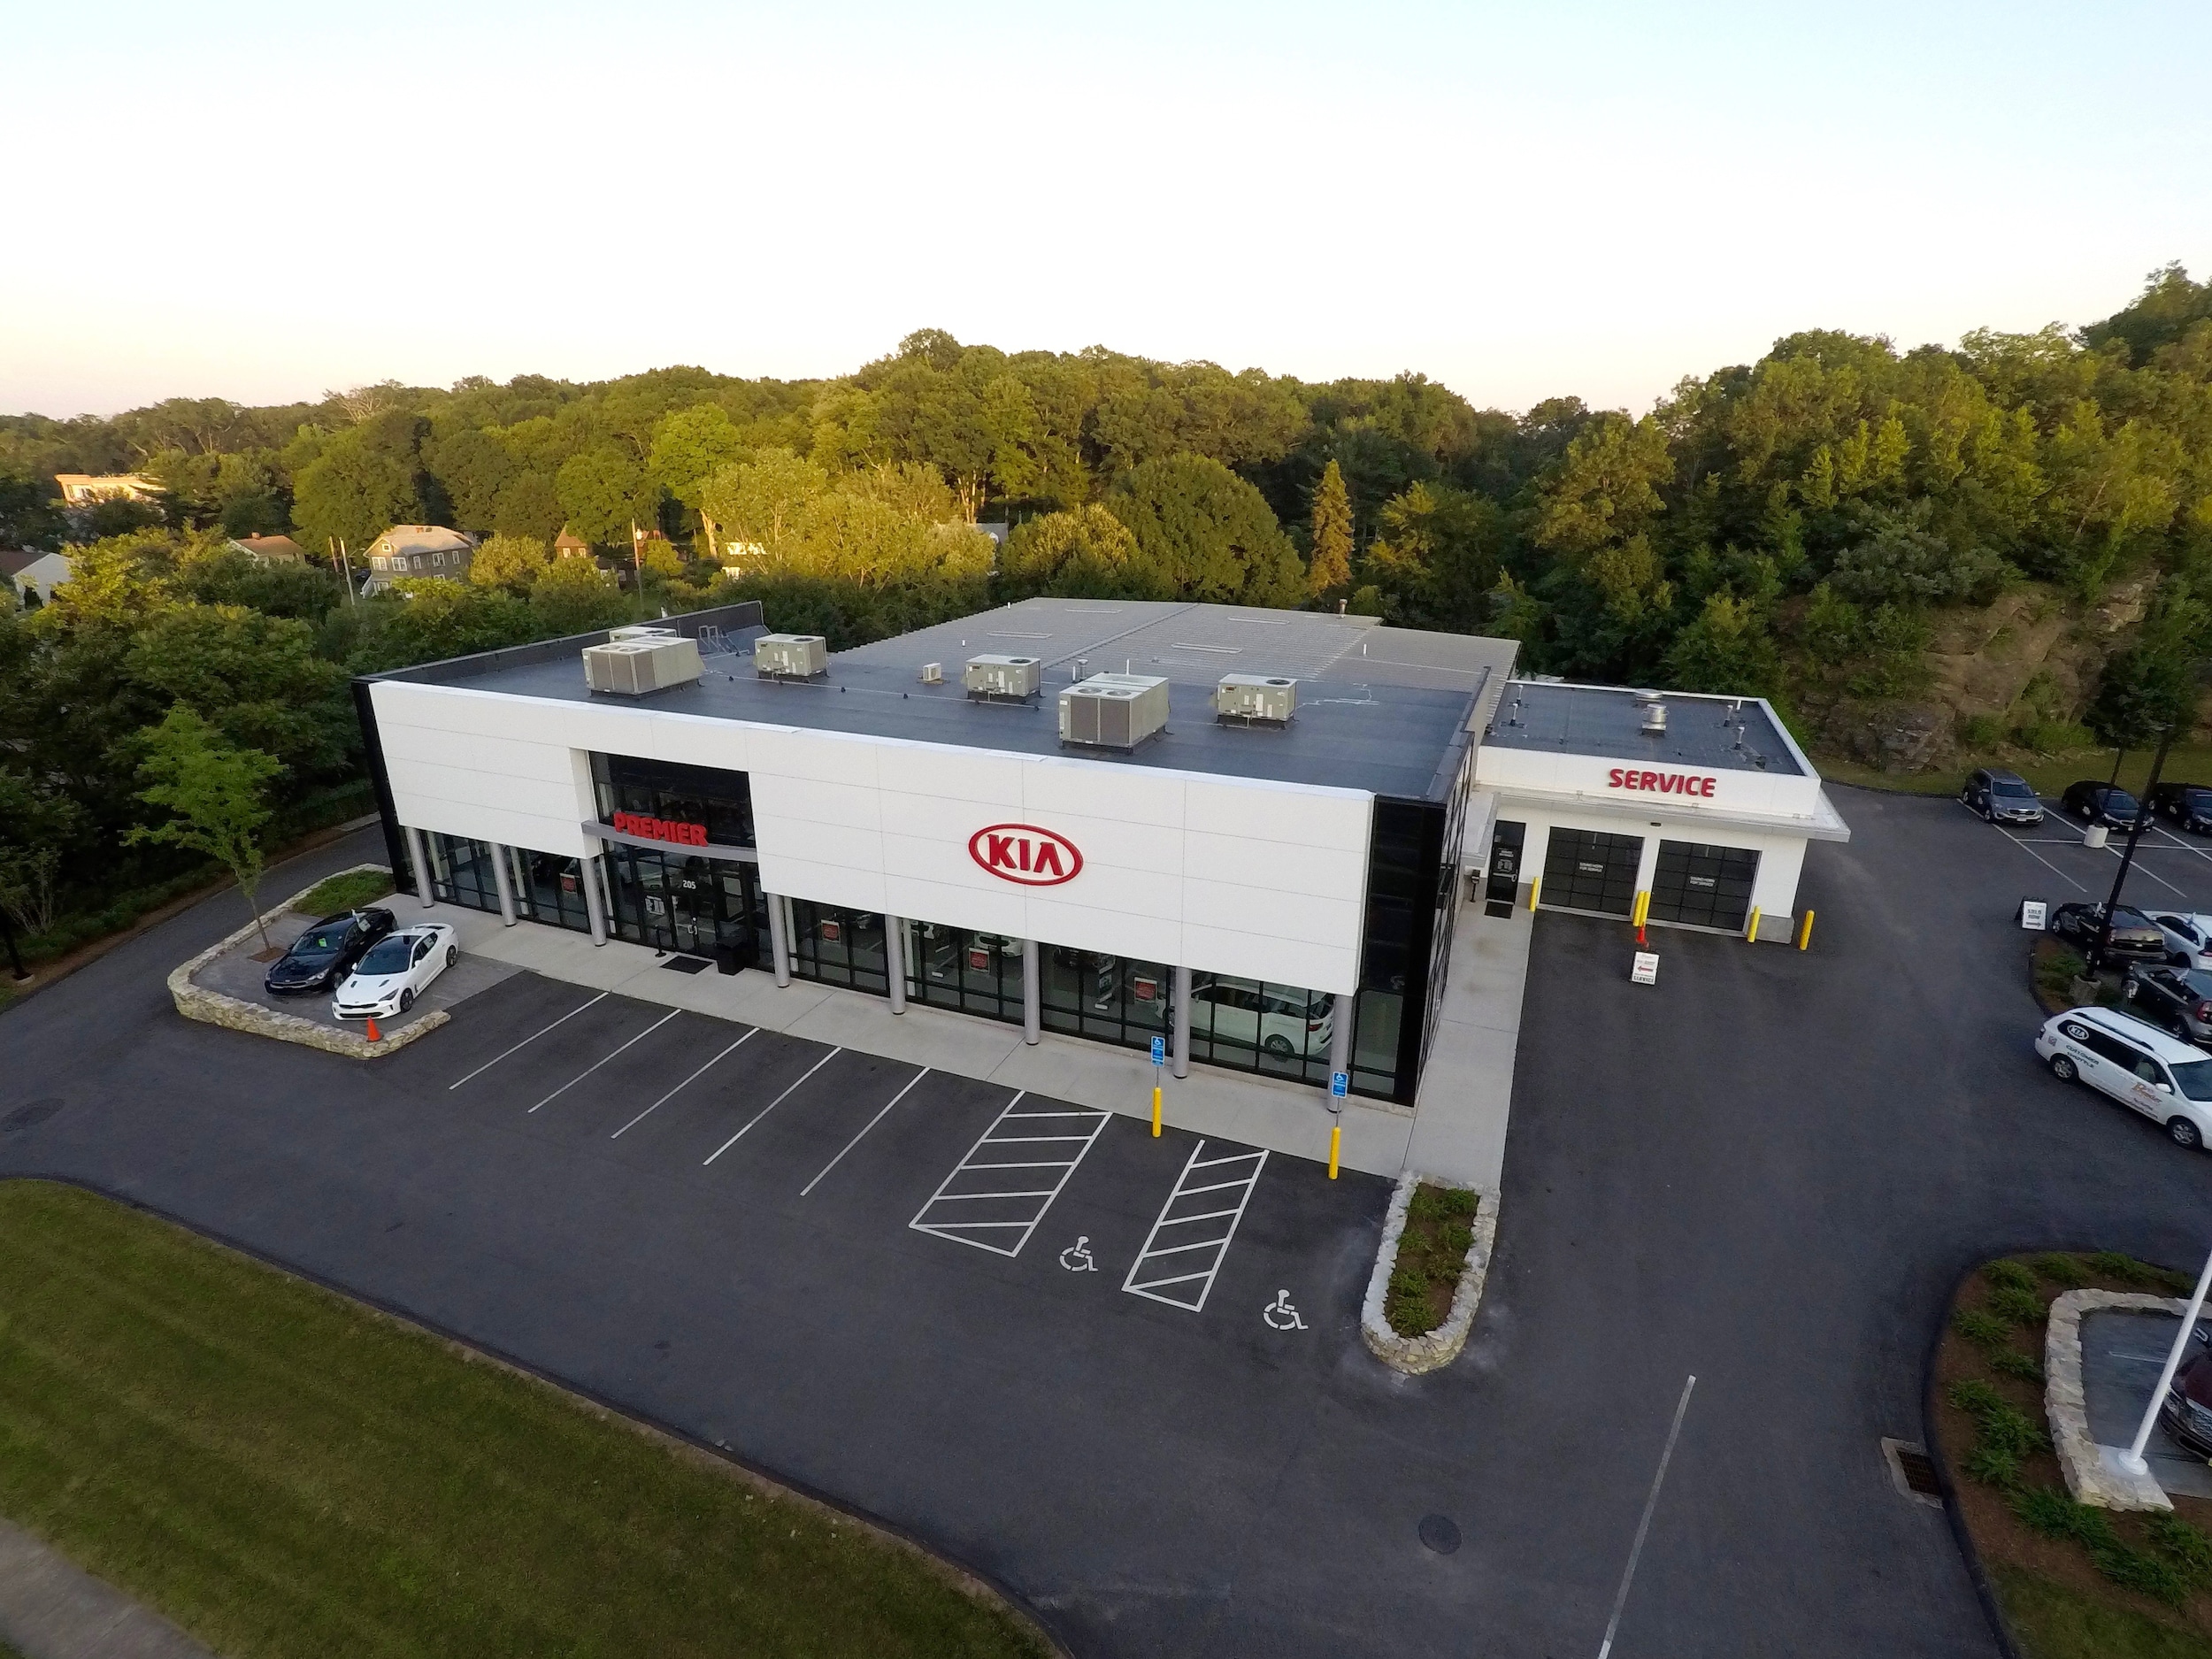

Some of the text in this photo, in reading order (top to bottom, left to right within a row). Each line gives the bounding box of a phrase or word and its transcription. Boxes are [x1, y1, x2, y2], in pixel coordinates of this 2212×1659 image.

[1609, 768, 1717, 797] SERVICE
[614, 810, 709, 847] PREMIER
[987, 834, 1064, 876] KIA
[682, 879, 696, 890] 205
